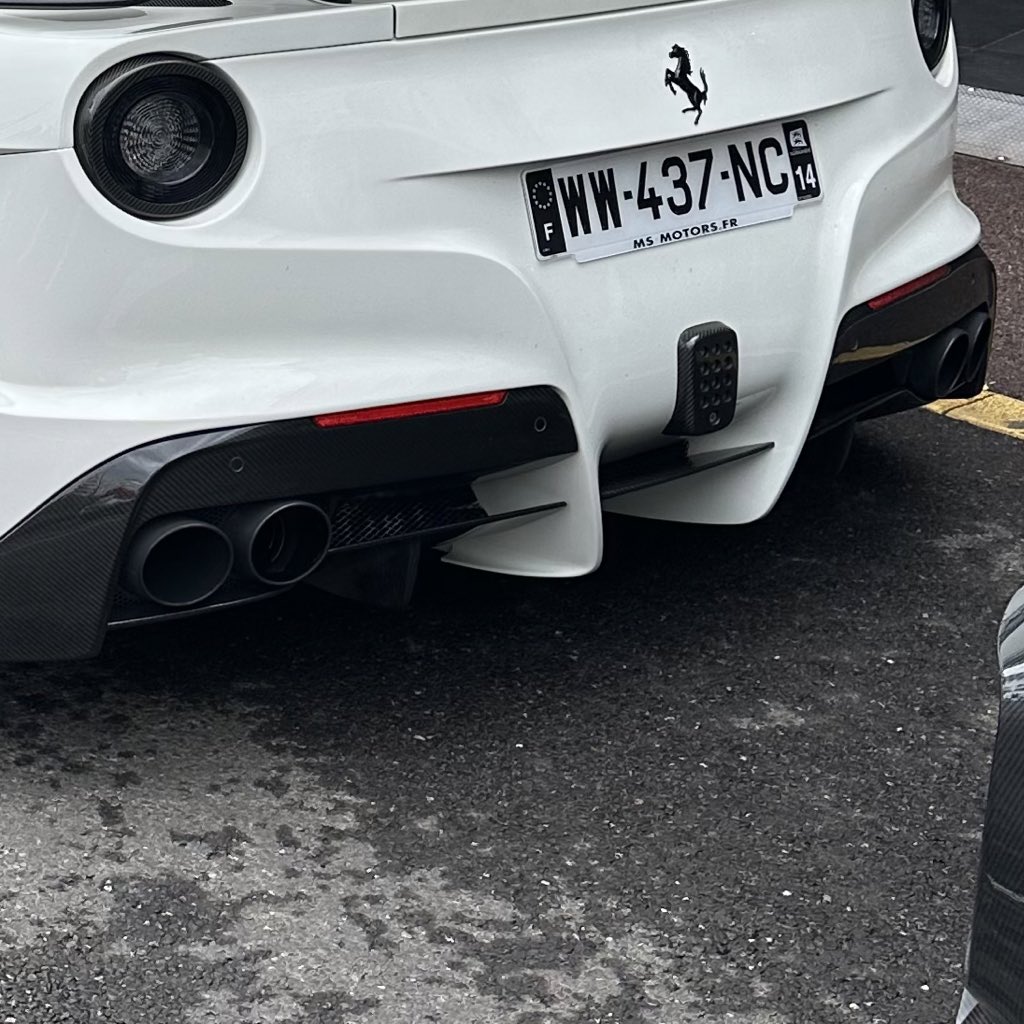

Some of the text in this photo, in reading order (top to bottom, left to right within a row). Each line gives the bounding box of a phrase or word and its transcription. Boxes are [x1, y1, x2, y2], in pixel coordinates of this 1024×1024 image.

[557, 137, 789, 238] WW-437-NC
[795, 163, 817, 190] 14
[543, 222, 554, 241] F
[633, 218, 738, 249] MS MOTORS.FR
